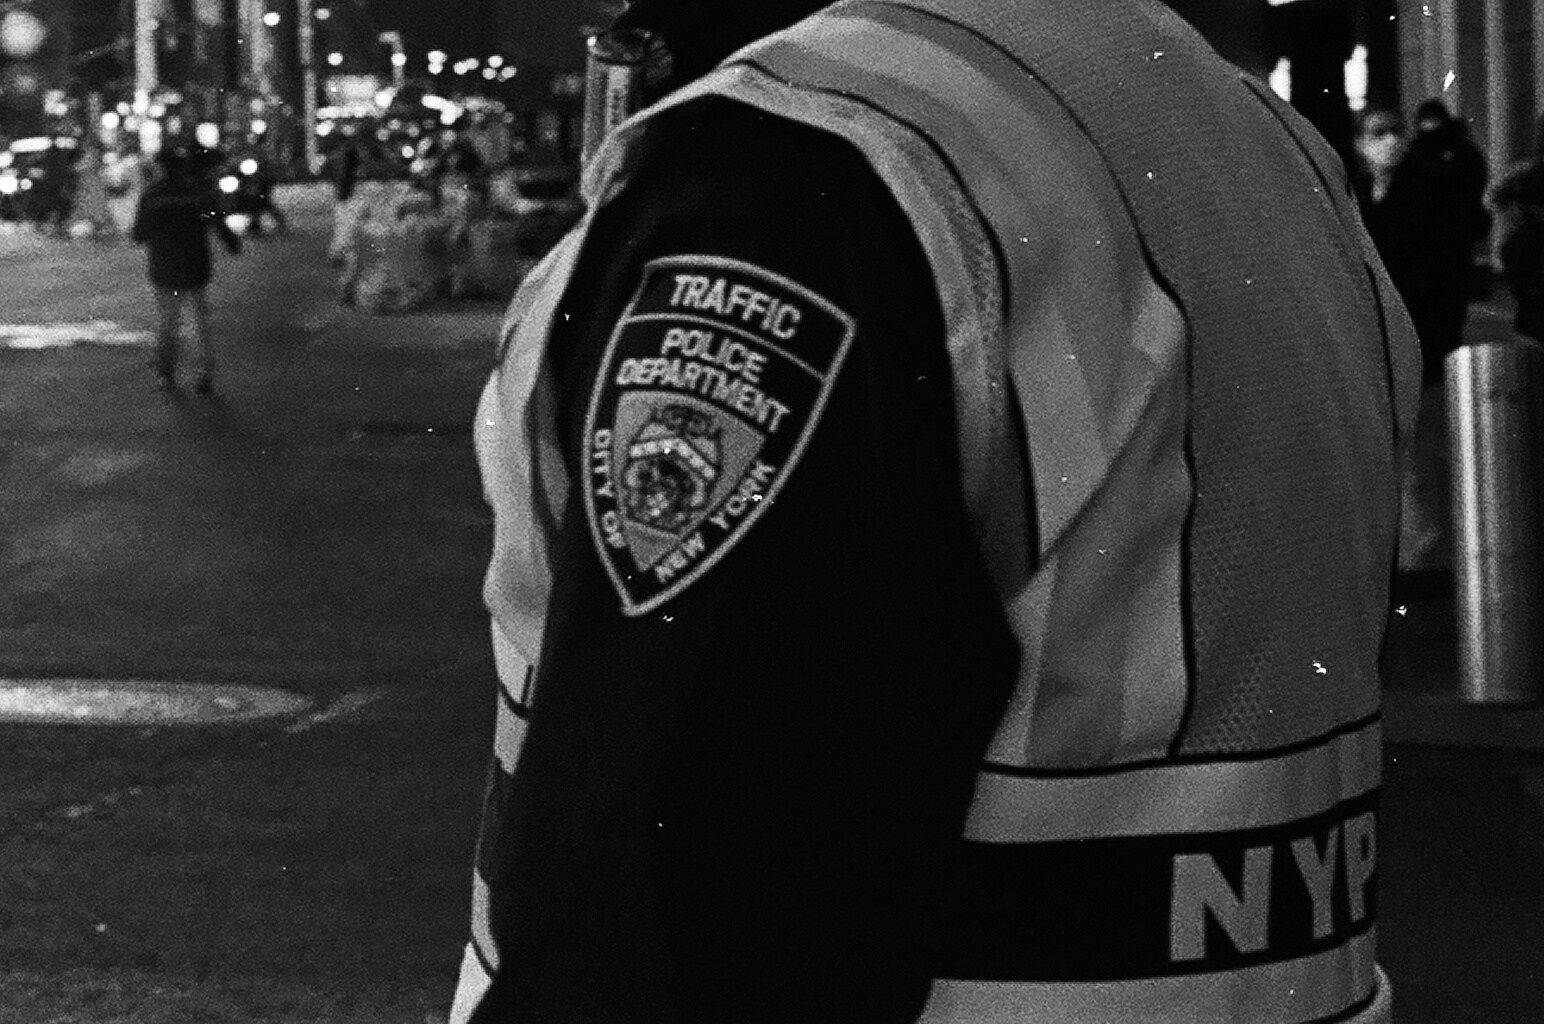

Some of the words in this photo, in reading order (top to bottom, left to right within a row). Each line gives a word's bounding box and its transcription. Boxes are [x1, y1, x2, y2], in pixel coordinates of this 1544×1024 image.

[670, 274, 801, 339] TRAFFIC
[661, 328, 767, 383] POLICE
[616, 358, 791, 432] DEPARTMENT
[655, 531, 705, 583] NEW
[709, 460, 776, 530] YORK
[1170, 811, 1377, 962] NYP
